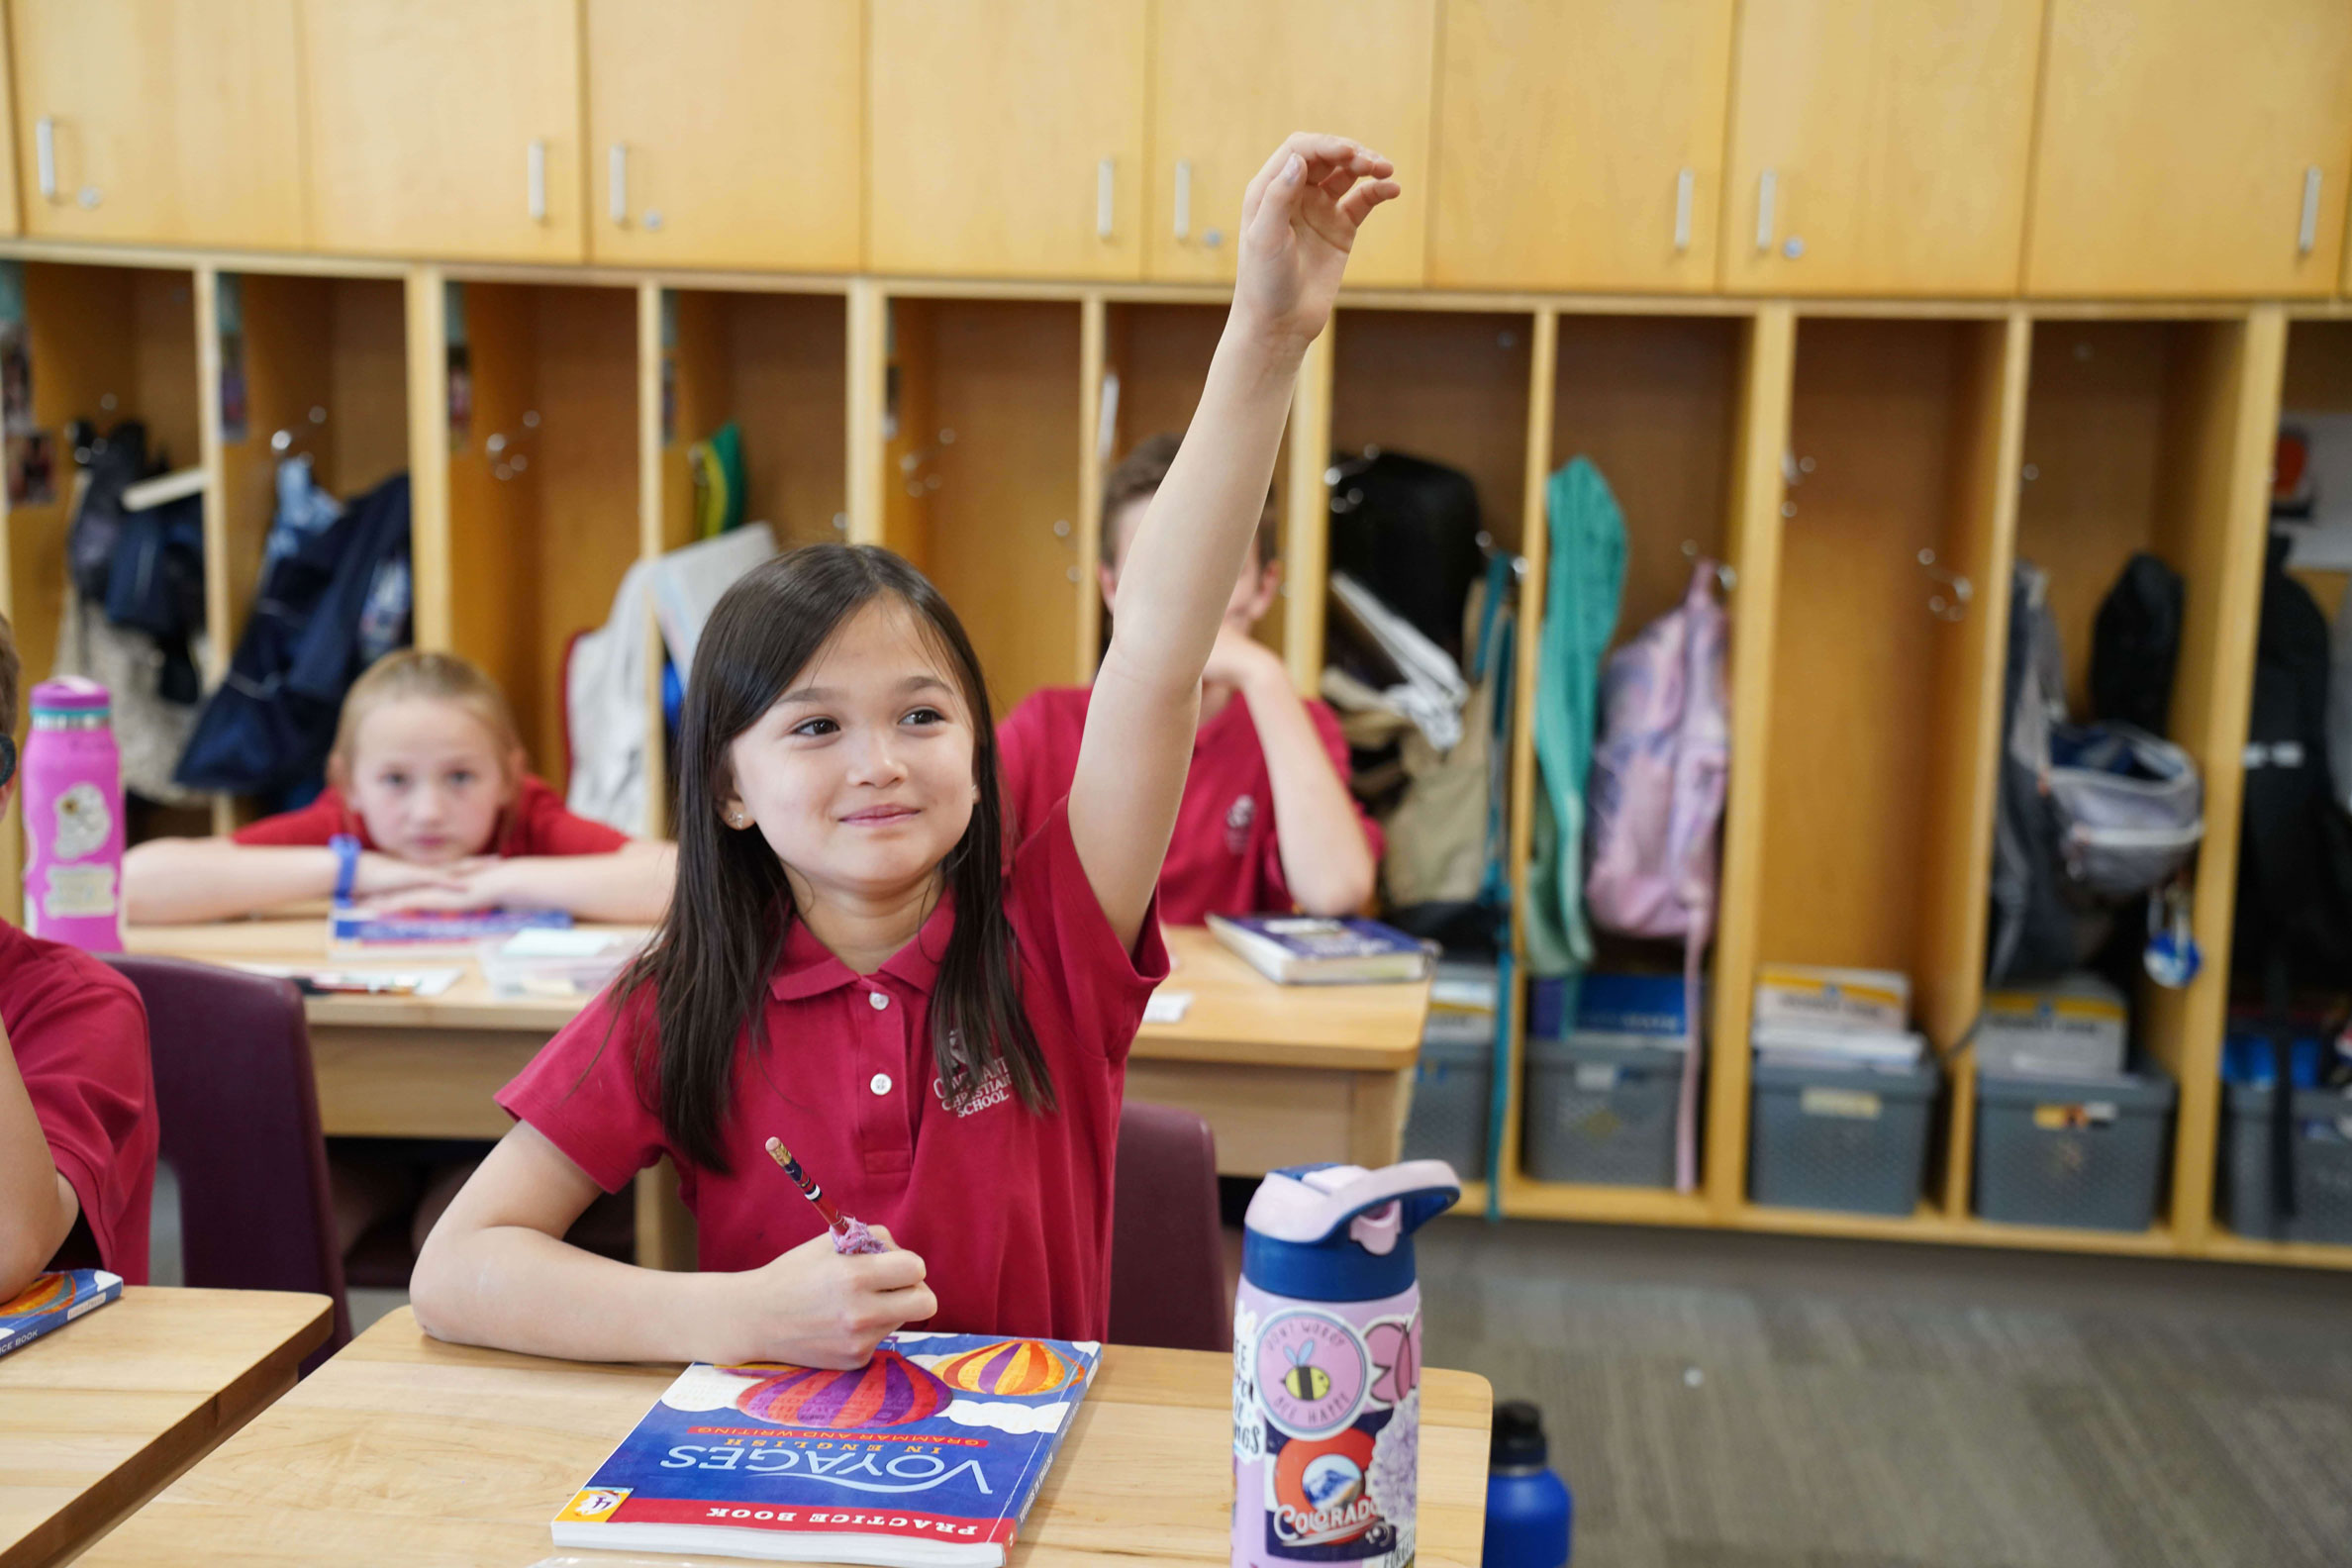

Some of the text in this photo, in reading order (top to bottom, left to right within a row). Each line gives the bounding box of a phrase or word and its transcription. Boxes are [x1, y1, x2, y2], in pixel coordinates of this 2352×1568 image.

[958, 1090, 1010, 1118] SCHOOL
[15, 1328, 39, 1346] BOOK
[697, 1427, 793, 1437] WRITING
[859, 1433, 979, 1446] GRAMMAR
[724, 1438, 942, 1454] IN ENGLISH
[660, 1445, 993, 1495] VOYAGES
[592, 1497, 612, 1510] 4
[706, 1508, 978, 1535] PRACTICE BOOK
